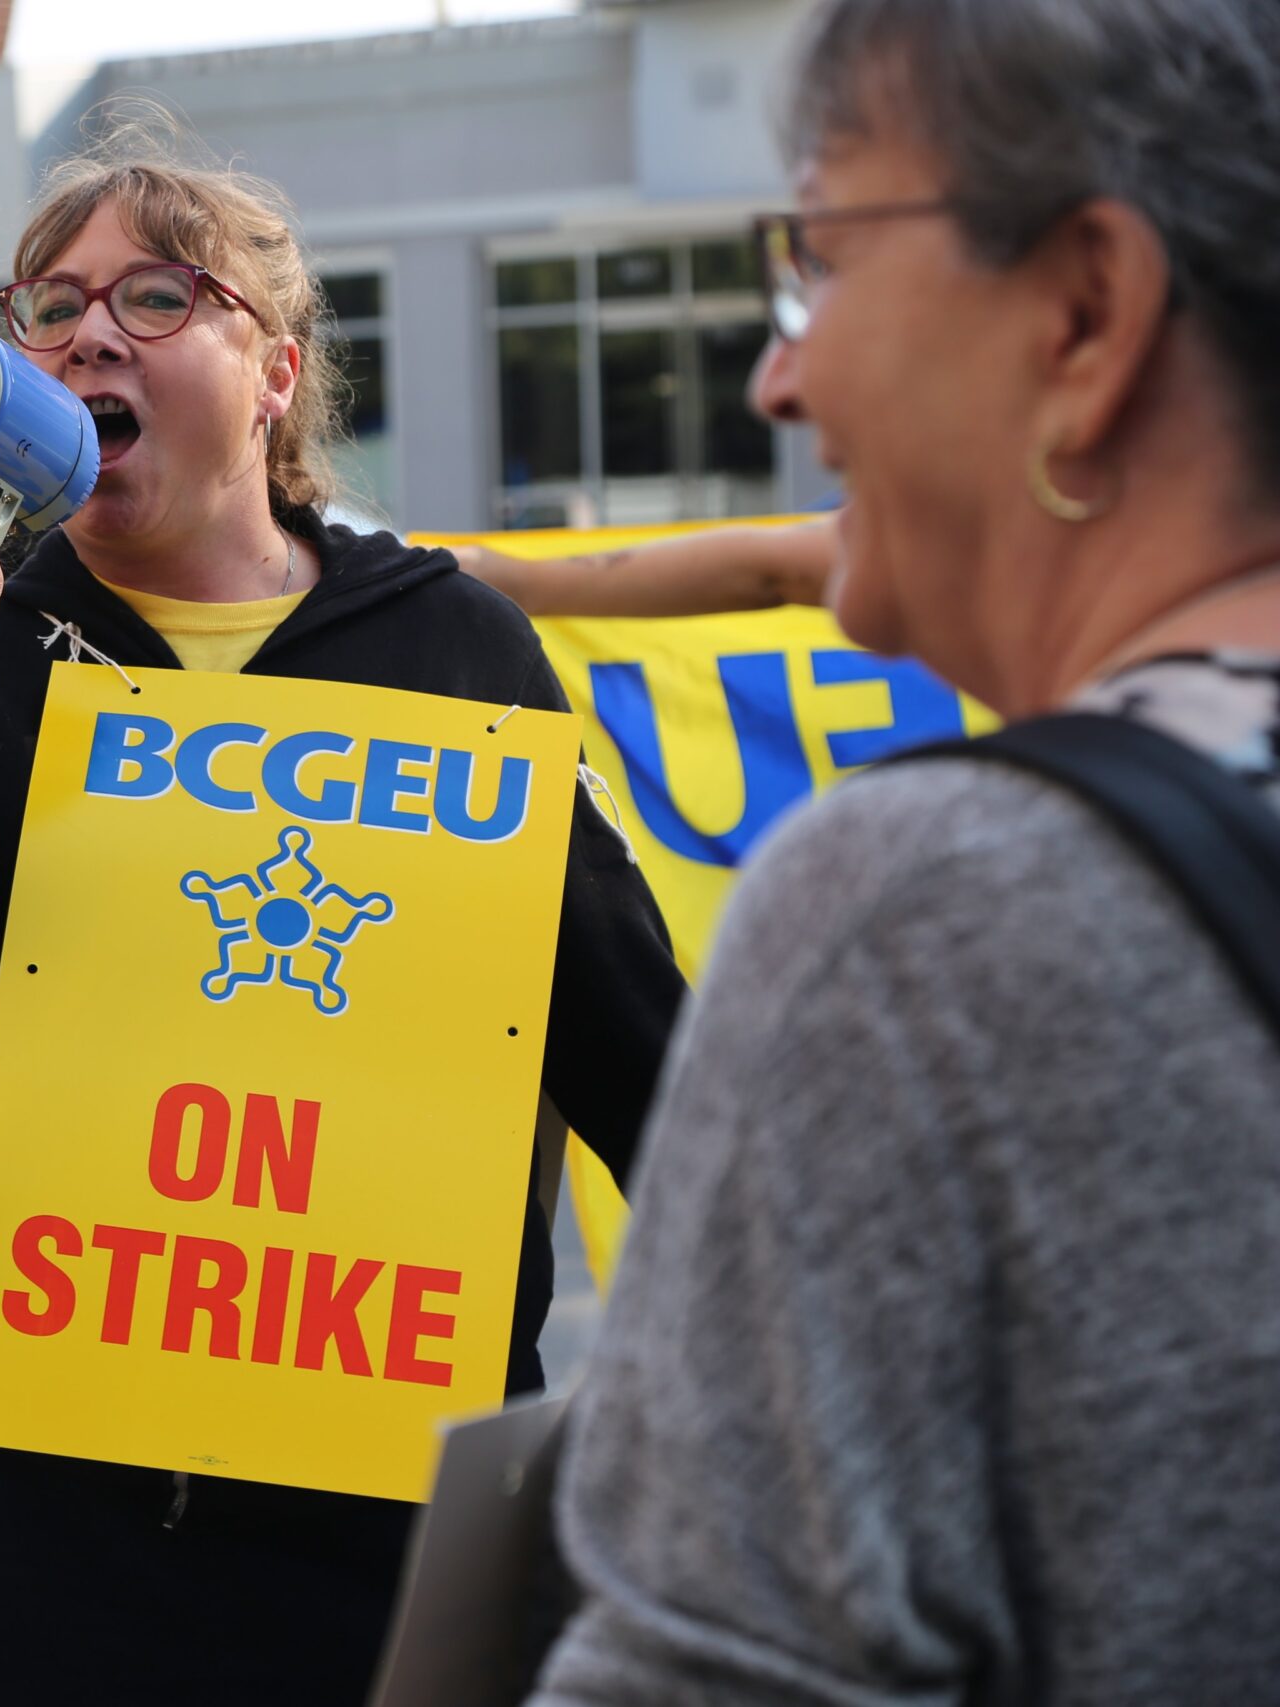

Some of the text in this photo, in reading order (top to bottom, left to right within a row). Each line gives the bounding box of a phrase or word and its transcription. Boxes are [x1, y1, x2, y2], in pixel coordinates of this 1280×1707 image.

[84, 712, 532, 844] BCGEU
[148, 1083, 321, 1214] ON
[1, 1214, 463, 1388] STRIKE
